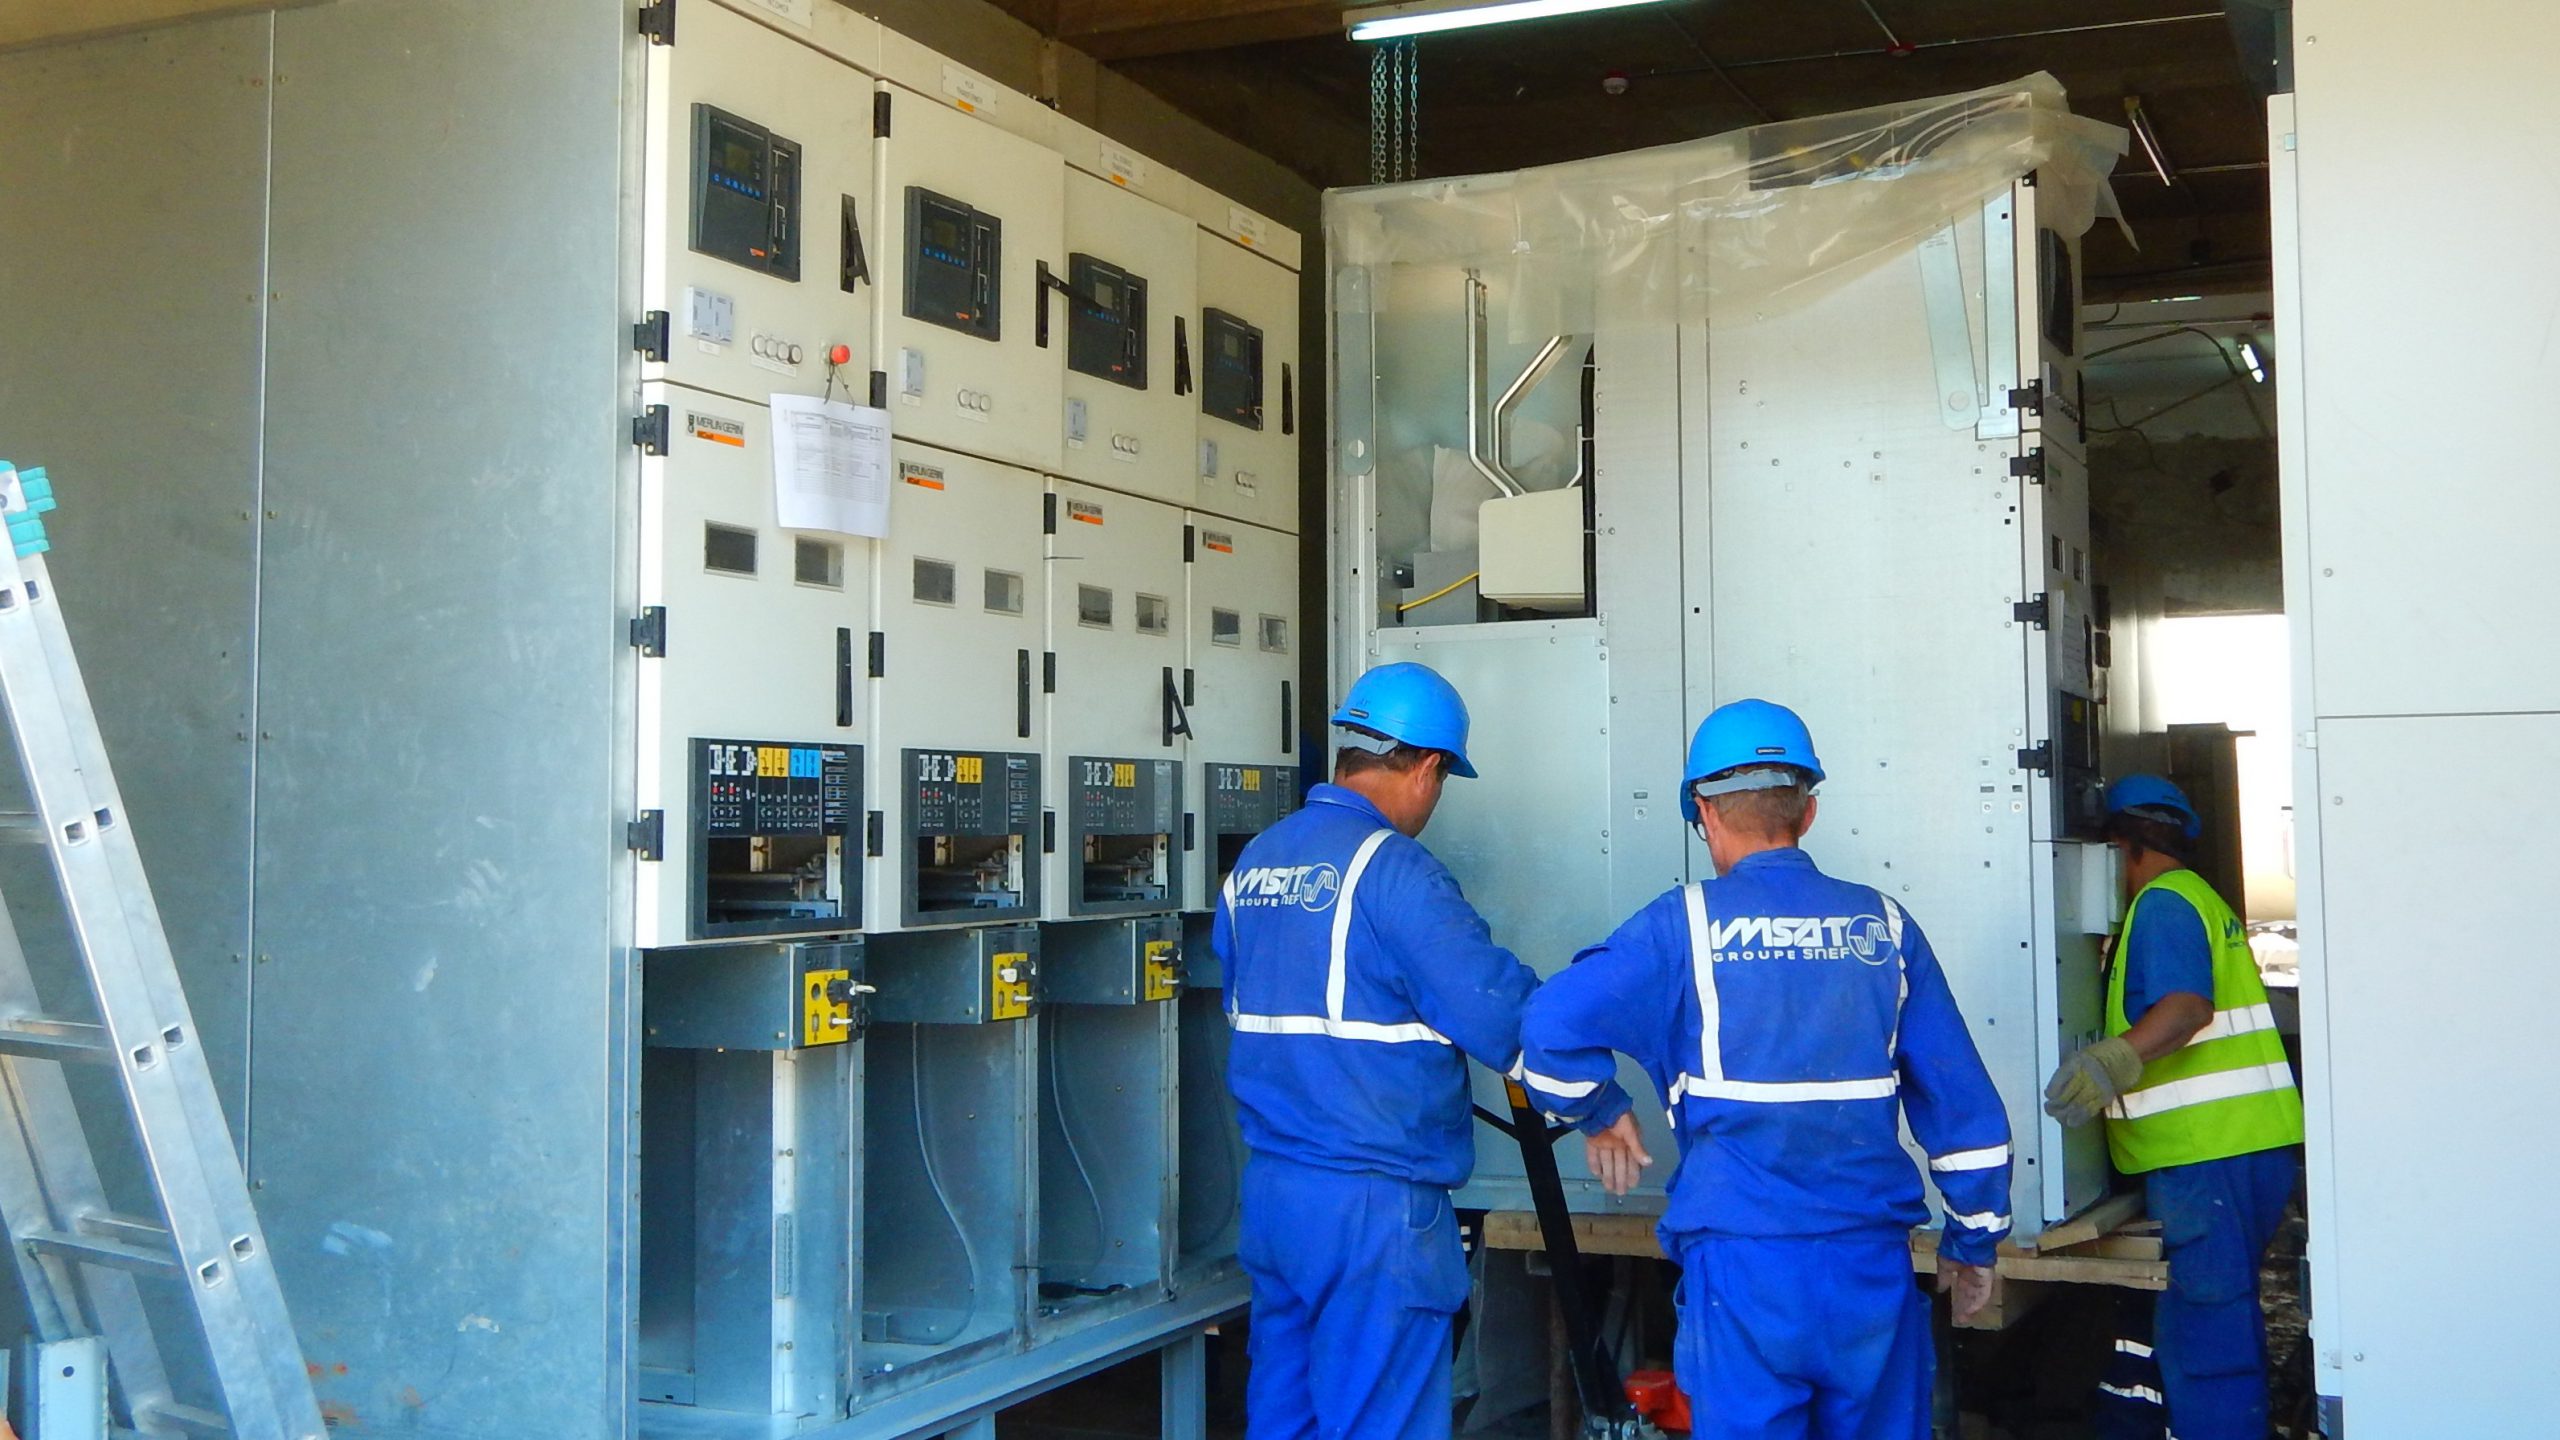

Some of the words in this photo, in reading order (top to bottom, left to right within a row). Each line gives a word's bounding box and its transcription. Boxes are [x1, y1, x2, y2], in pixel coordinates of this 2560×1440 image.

[696, 415, 722, 430] MERLIN
[723, 421, 744, 436] GERIN
[1712, 949, 1796, 963] GROUPE
[1803, 948, 1850, 960] SNEF
